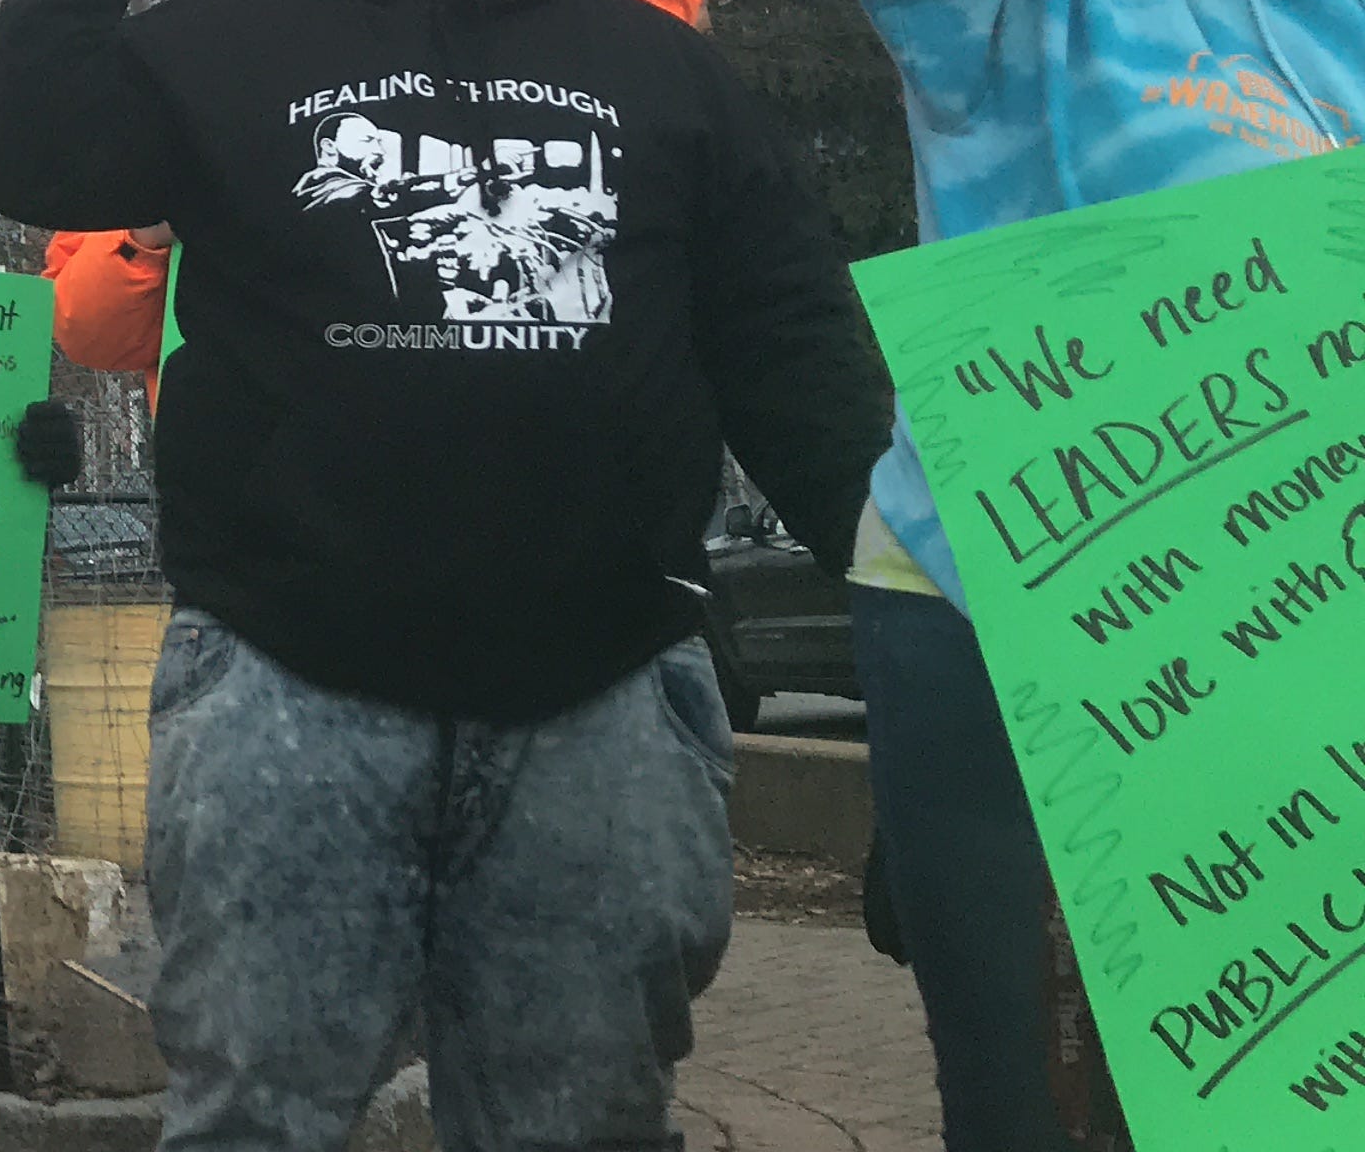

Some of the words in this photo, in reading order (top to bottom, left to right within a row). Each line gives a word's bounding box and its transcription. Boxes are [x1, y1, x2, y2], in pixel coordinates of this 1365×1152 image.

[288, 71, 436, 125] HEALING
[324, 323, 589, 350] COMMUNITY
[1140, 237, 1288, 347] need
[975, 347, 1289, 563] LEADERS
[1307, 294, 1365, 379] no
[1073, 546, 1203, 645] with
[1080, 656, 1217, 755] love
[1221, 561, 1346, 660] with
[1148, 831, 1265, 926] Not
[1256, 789, 1341, 850] in
[1150, 869, 1365, 1070] PUBLIC
